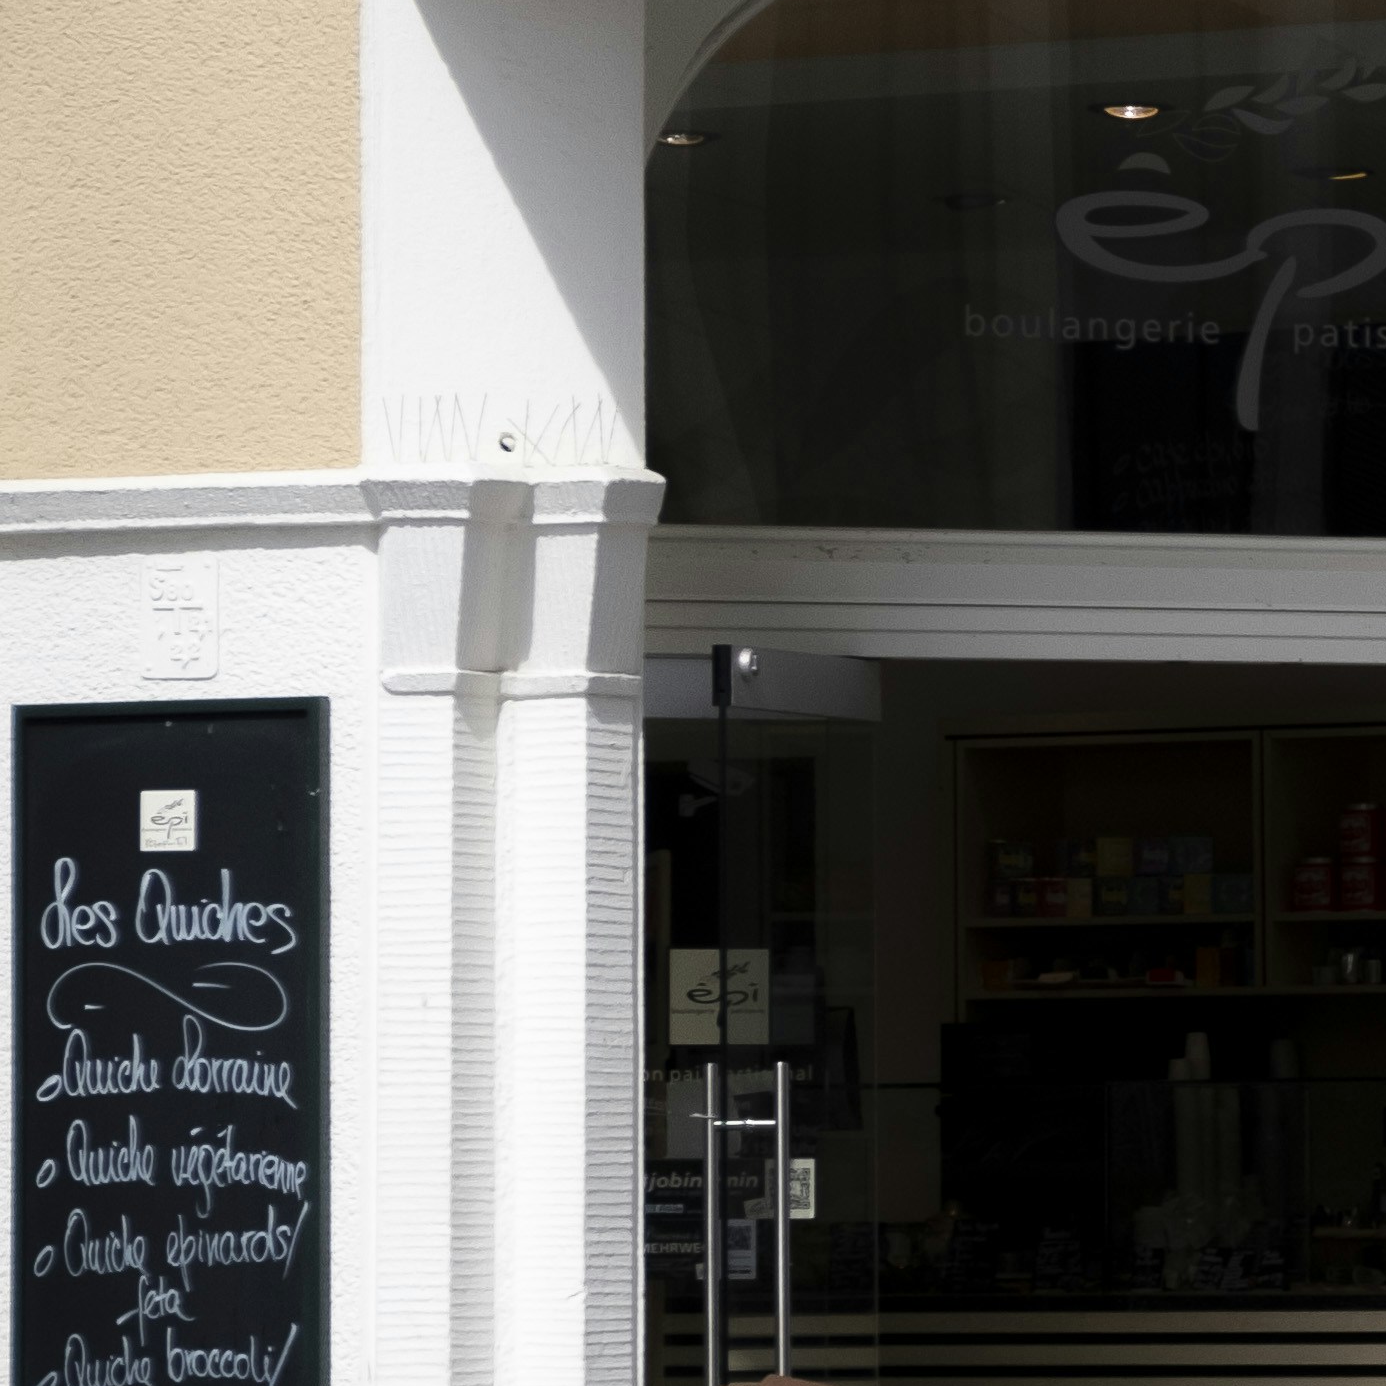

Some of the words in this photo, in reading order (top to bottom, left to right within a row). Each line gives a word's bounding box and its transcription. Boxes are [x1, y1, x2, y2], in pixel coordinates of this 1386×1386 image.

[964, 304, 1221, 351] boulangerie
[41, 857, 117, 949] Les
[135, 868, 297, 955] Quiches
[63, 1029, 161, 1097] Quiche
[171, 1014, 298, 1110] Lorraine
[66, 1115, 156, 1186] Quiche
[171, 1124, 307, 1219] végétarienne
[63, 1208, 150, 1278] Quiche
[116, 1274, 196, 1347] feta
